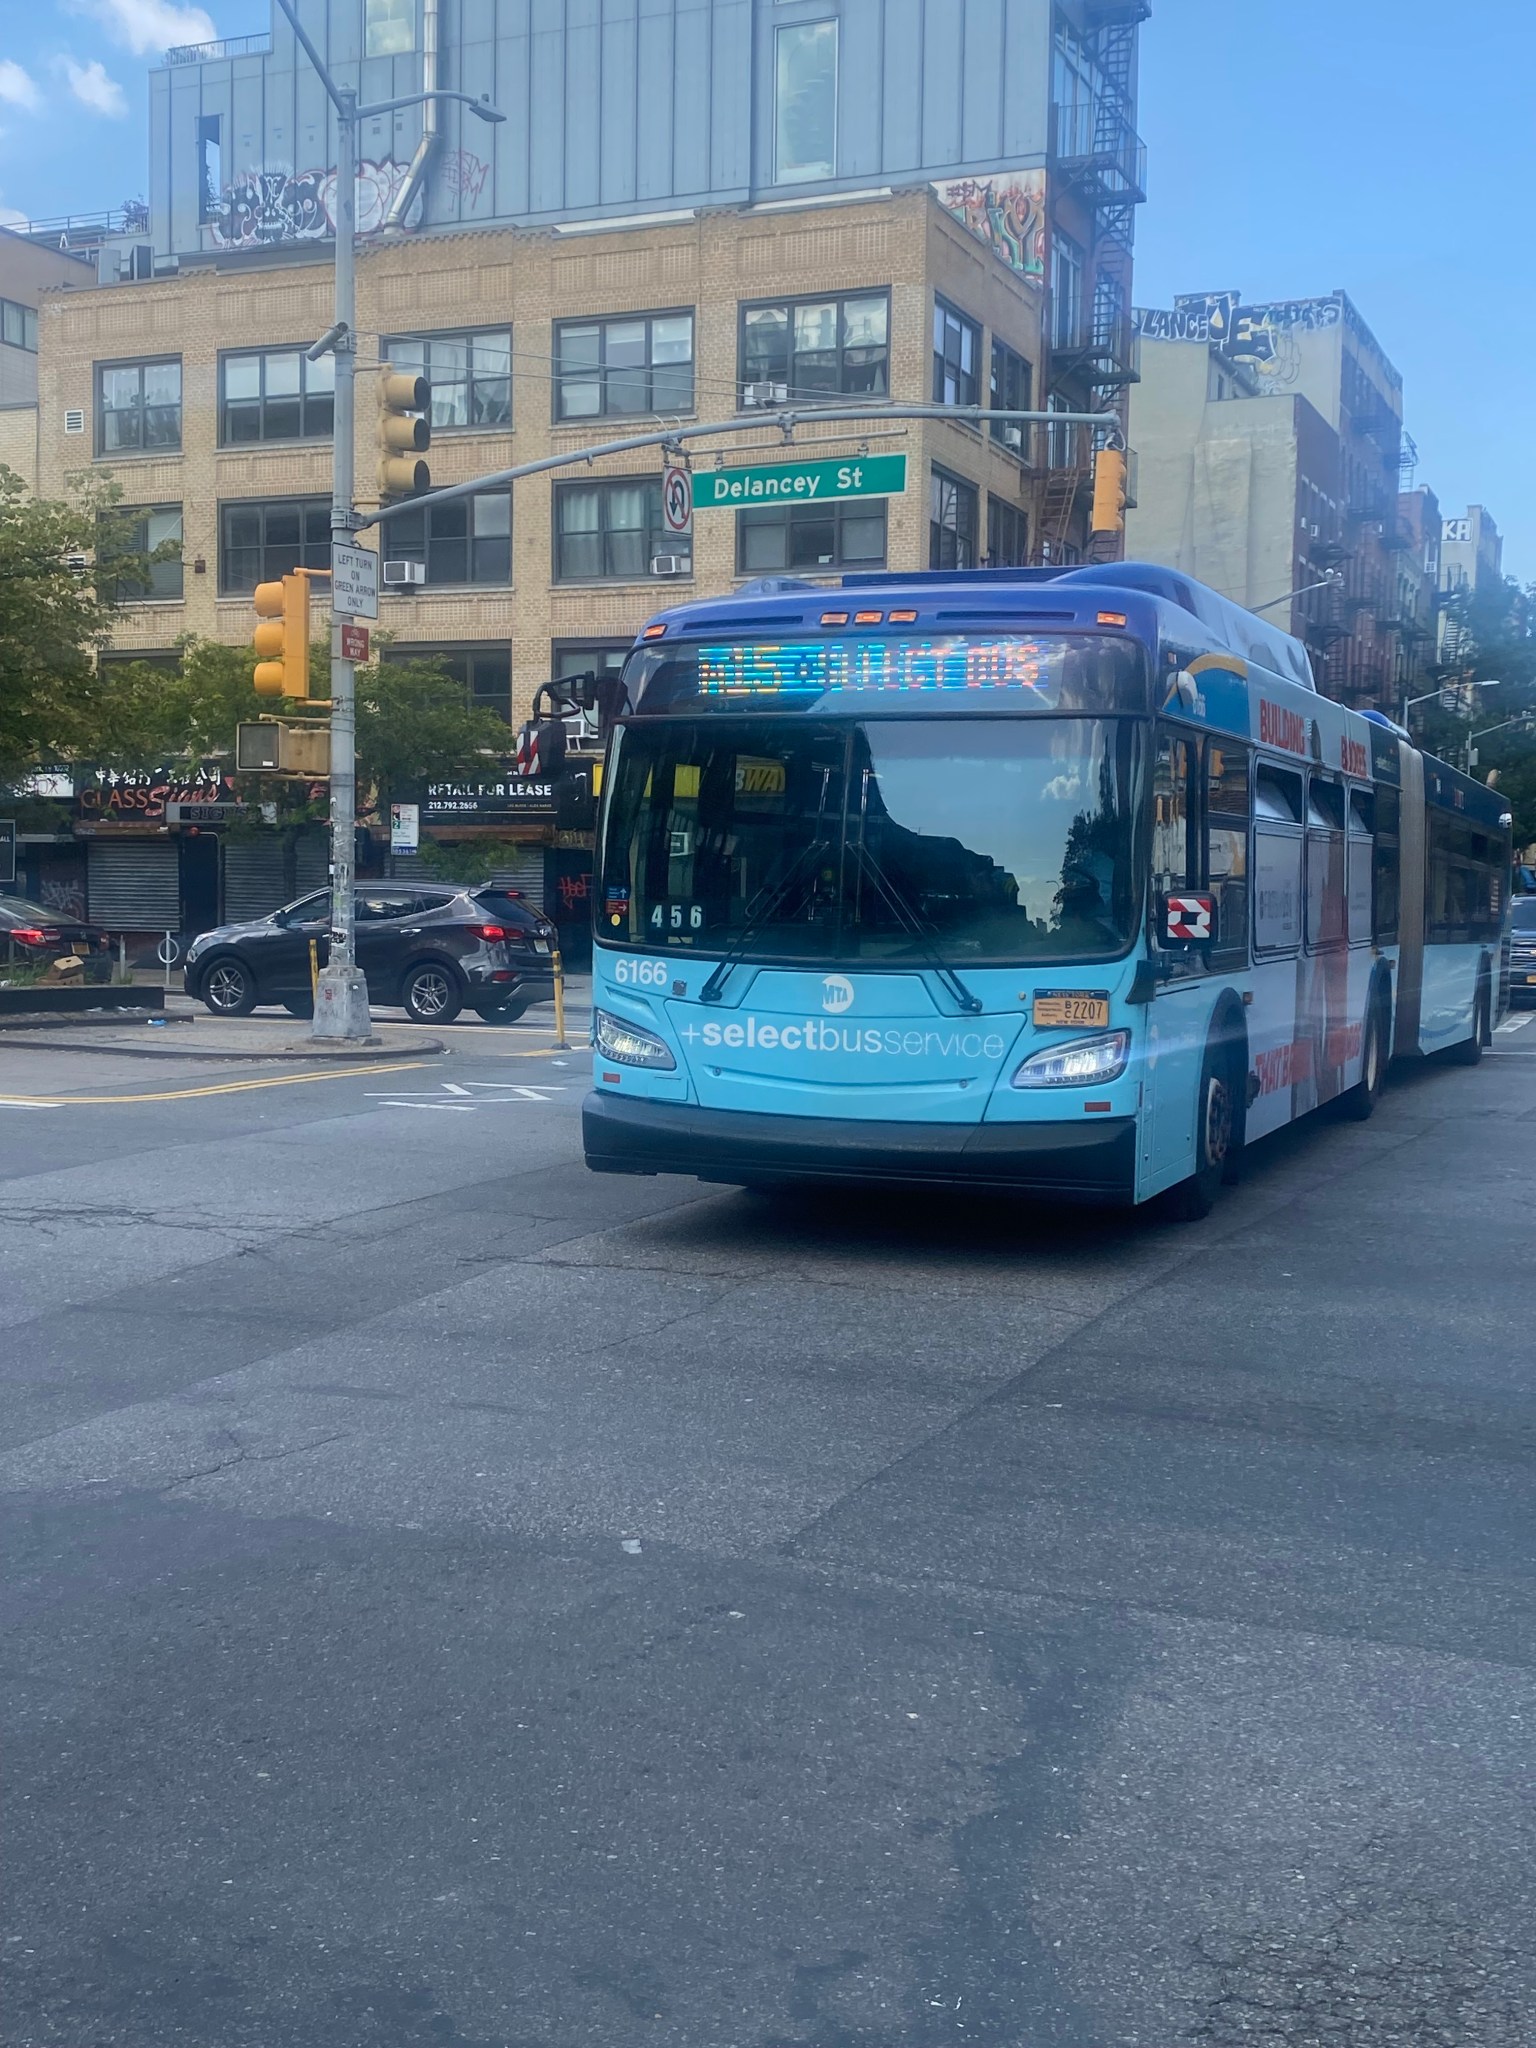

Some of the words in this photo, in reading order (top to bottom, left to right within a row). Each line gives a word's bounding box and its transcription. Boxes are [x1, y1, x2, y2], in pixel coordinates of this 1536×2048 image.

[714, 476, 821, 499] Delancey
[837, 467, 863, 489] St
[338, 554, 353, 567] LEFT
[356, 557, 372, 570] TURN
[351, 570, 360, 580] ON
[335, 580, 354, 593] GREEN
[355, 586, 376, 598] ARROW
[347, 596, 364, 608] ONLY
[346, 638, 365, 649] WRONG
[350, 648, 361, 657] WAY
[1260, 698, 1306, 756] BUILDING
[478, 784, 505, 796] FOR
[509, 783, 552, 796] LEASE
[80, 789, 148, 809] GLASS
[615, 959, 668, 985] 6166
[822, 983, 849, 1004] MTA
